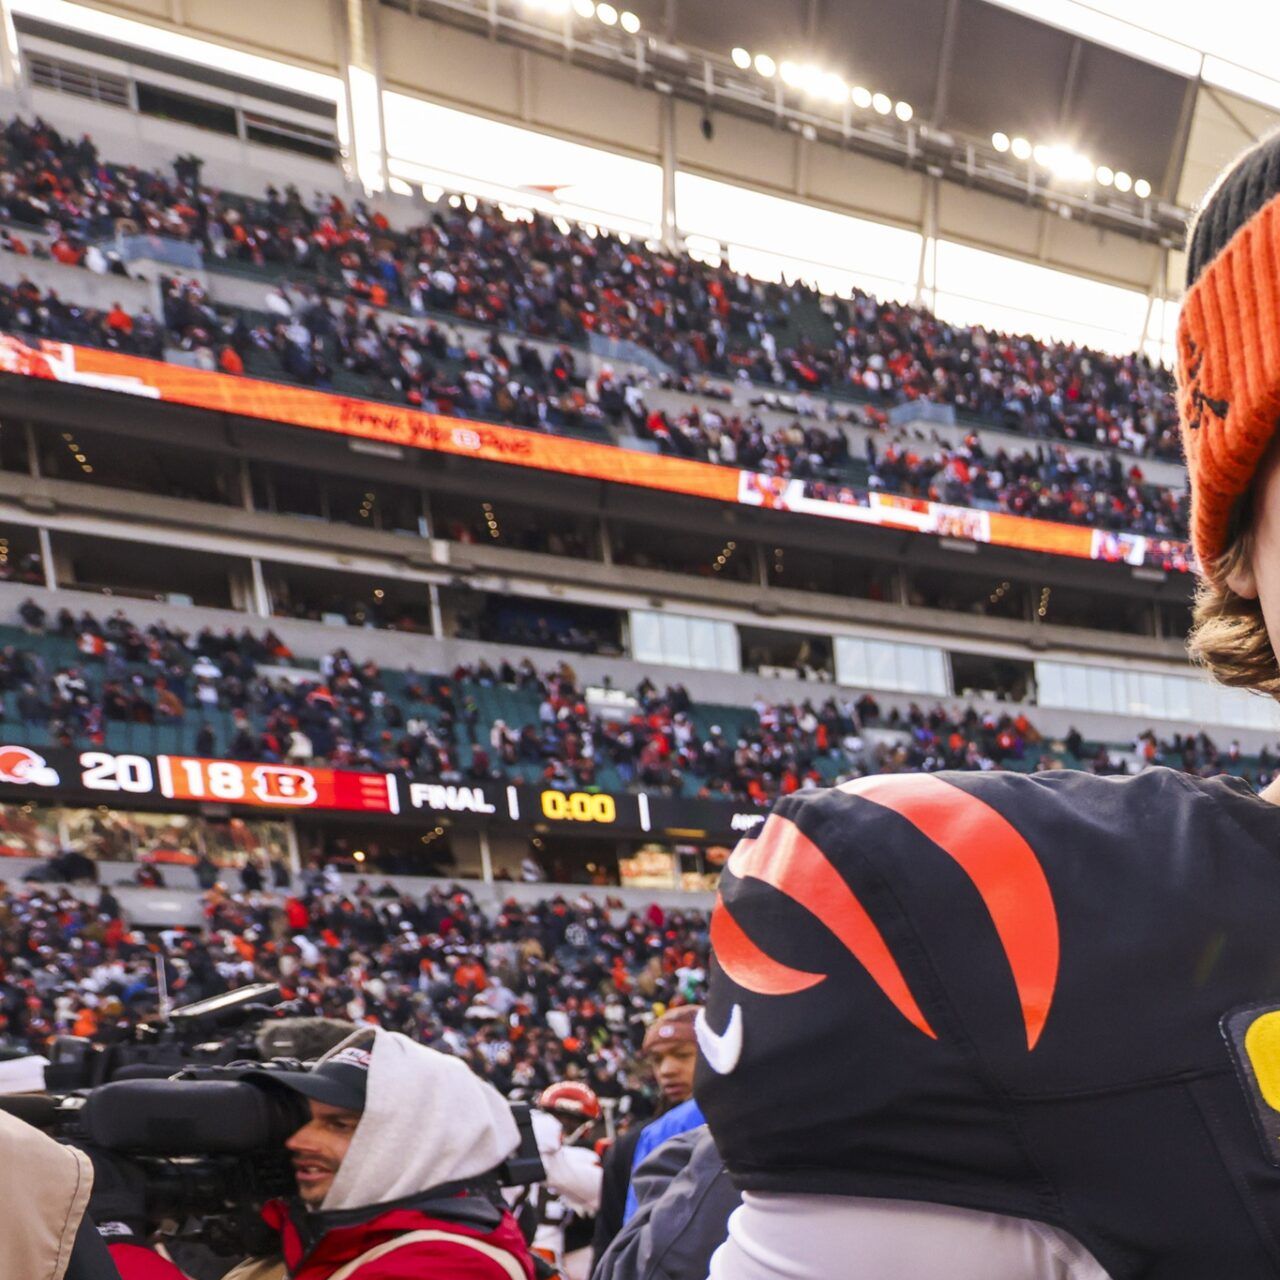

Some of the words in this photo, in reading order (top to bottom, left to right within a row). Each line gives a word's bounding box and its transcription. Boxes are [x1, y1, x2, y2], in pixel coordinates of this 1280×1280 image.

[80, 752, 152, 793] 20
[180, 759, 244, 798] 18
[410, 783, 496, 815] FINAL
[541, 790, 617, 824] 0:00
